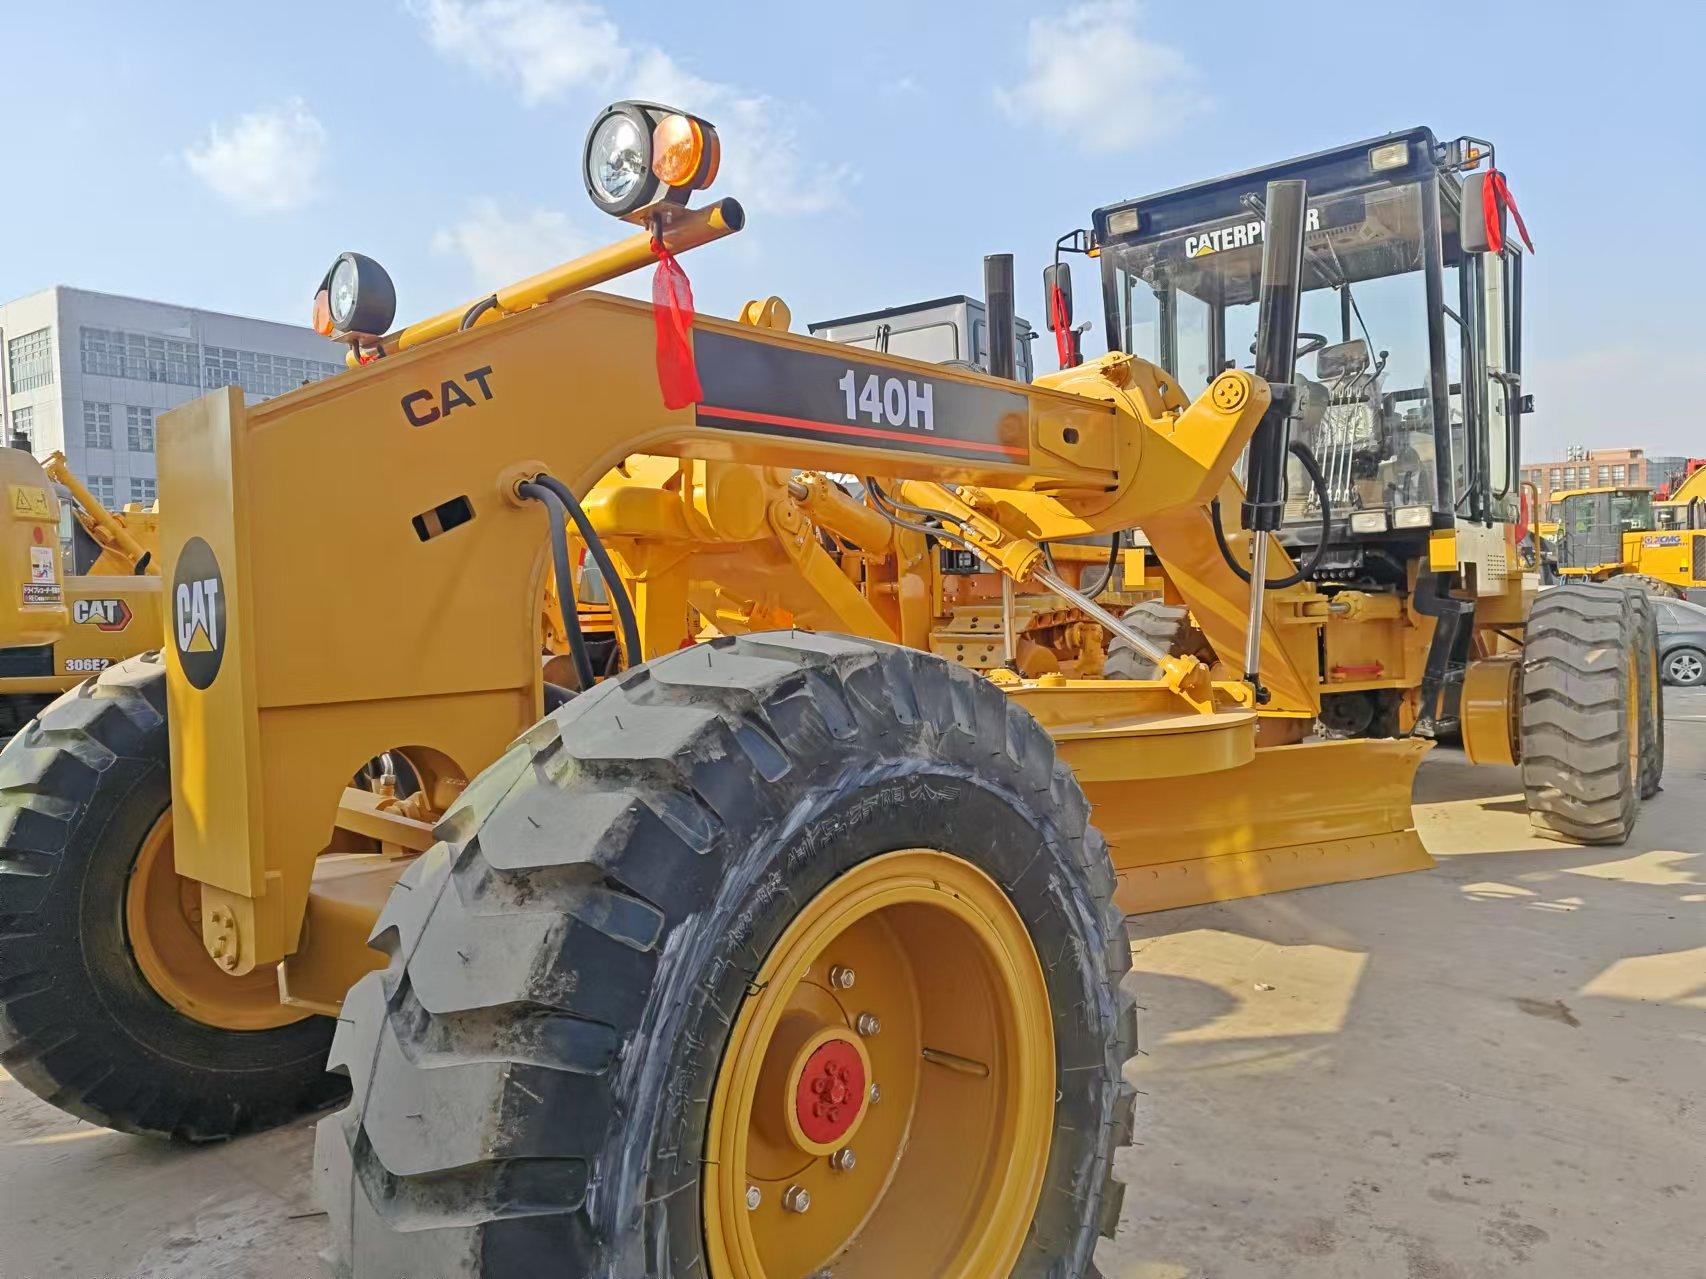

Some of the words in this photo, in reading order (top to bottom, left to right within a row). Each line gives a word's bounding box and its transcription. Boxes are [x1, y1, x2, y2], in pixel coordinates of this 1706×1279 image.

[1185, 208, 1320, 259] CATERPIR
[400, 365, 494, 427] CAT
[839, 369, 934, 431] 140H
[1654, 535, 1681, 545] XCMG
[73, 600, 117, 624] CAT
[176, 578, 218, 652] CAT
[65, 658, 109, 671] 306E2
